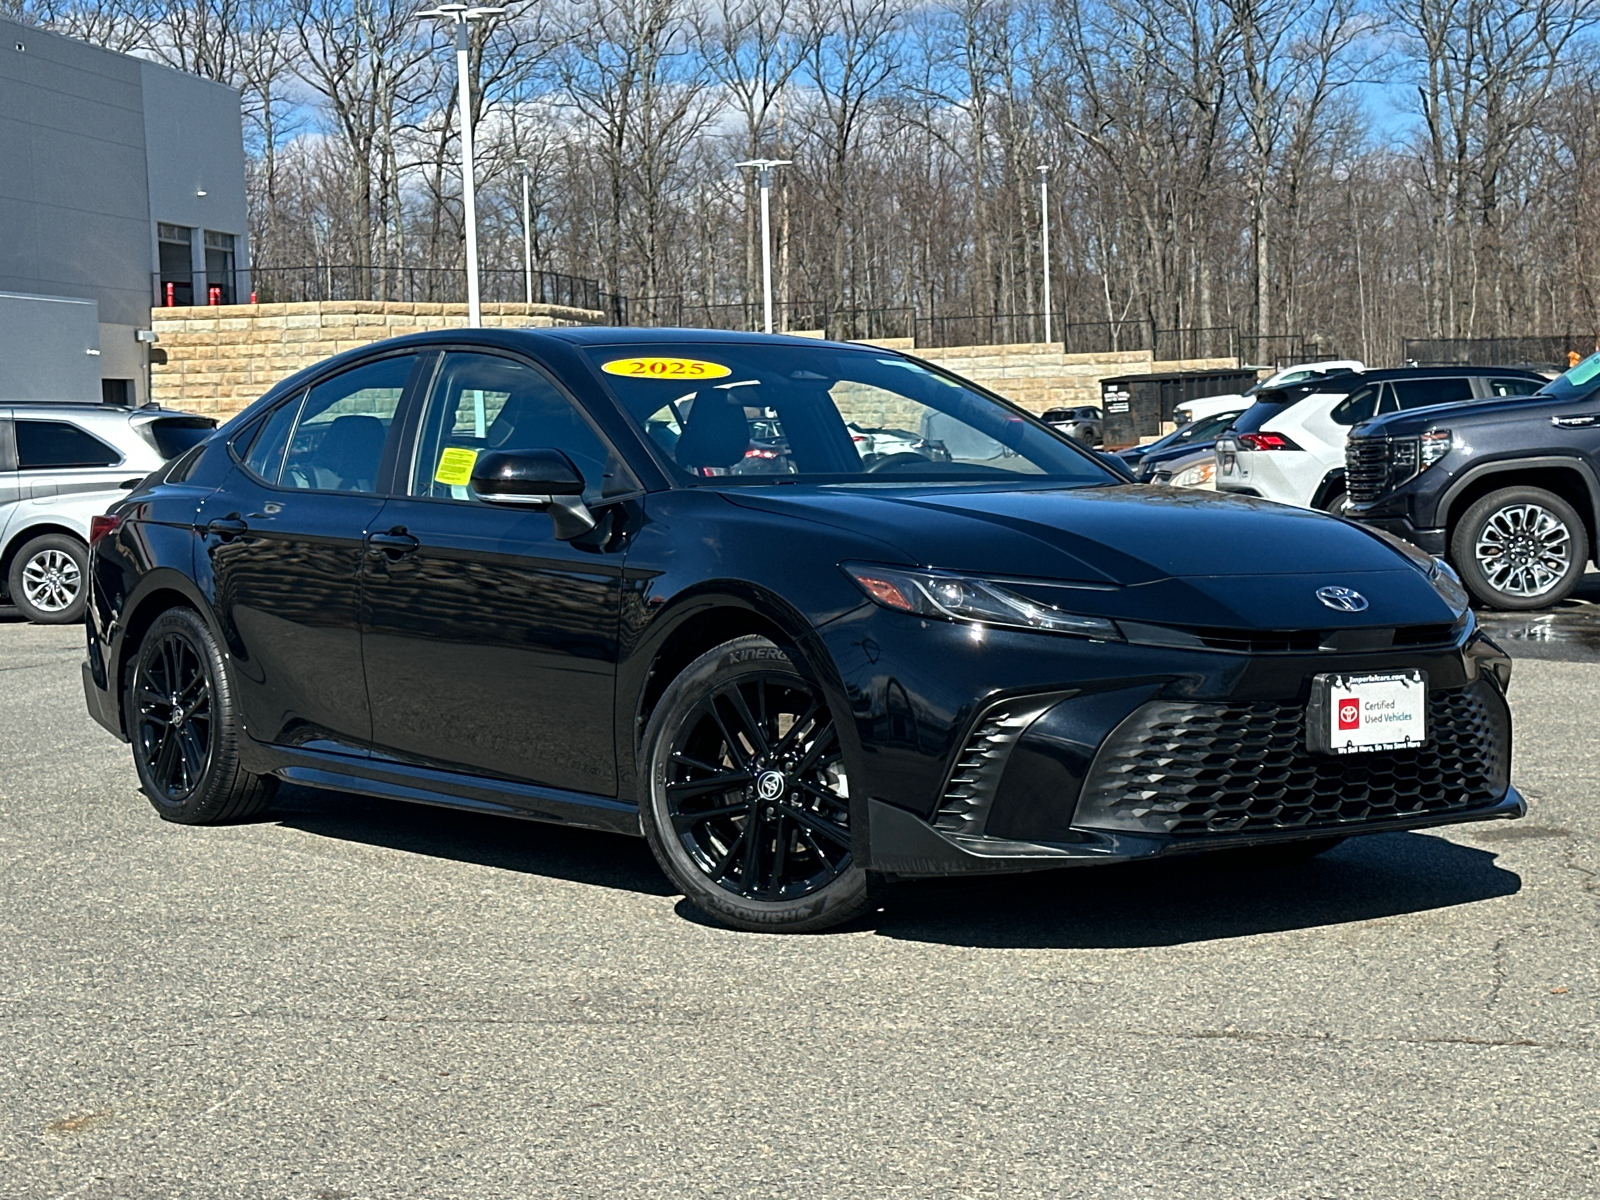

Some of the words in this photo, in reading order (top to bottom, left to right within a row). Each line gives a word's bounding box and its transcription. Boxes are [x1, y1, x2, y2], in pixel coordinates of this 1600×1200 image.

[629, 362, 706, 375] 2025
[729, 648, 790, 664] KINERG
[1364, 700, 1395, 711] Certified
[1364, 713, 1383, 724] Used
[1384, 712, 1412, 722] Vehicles
